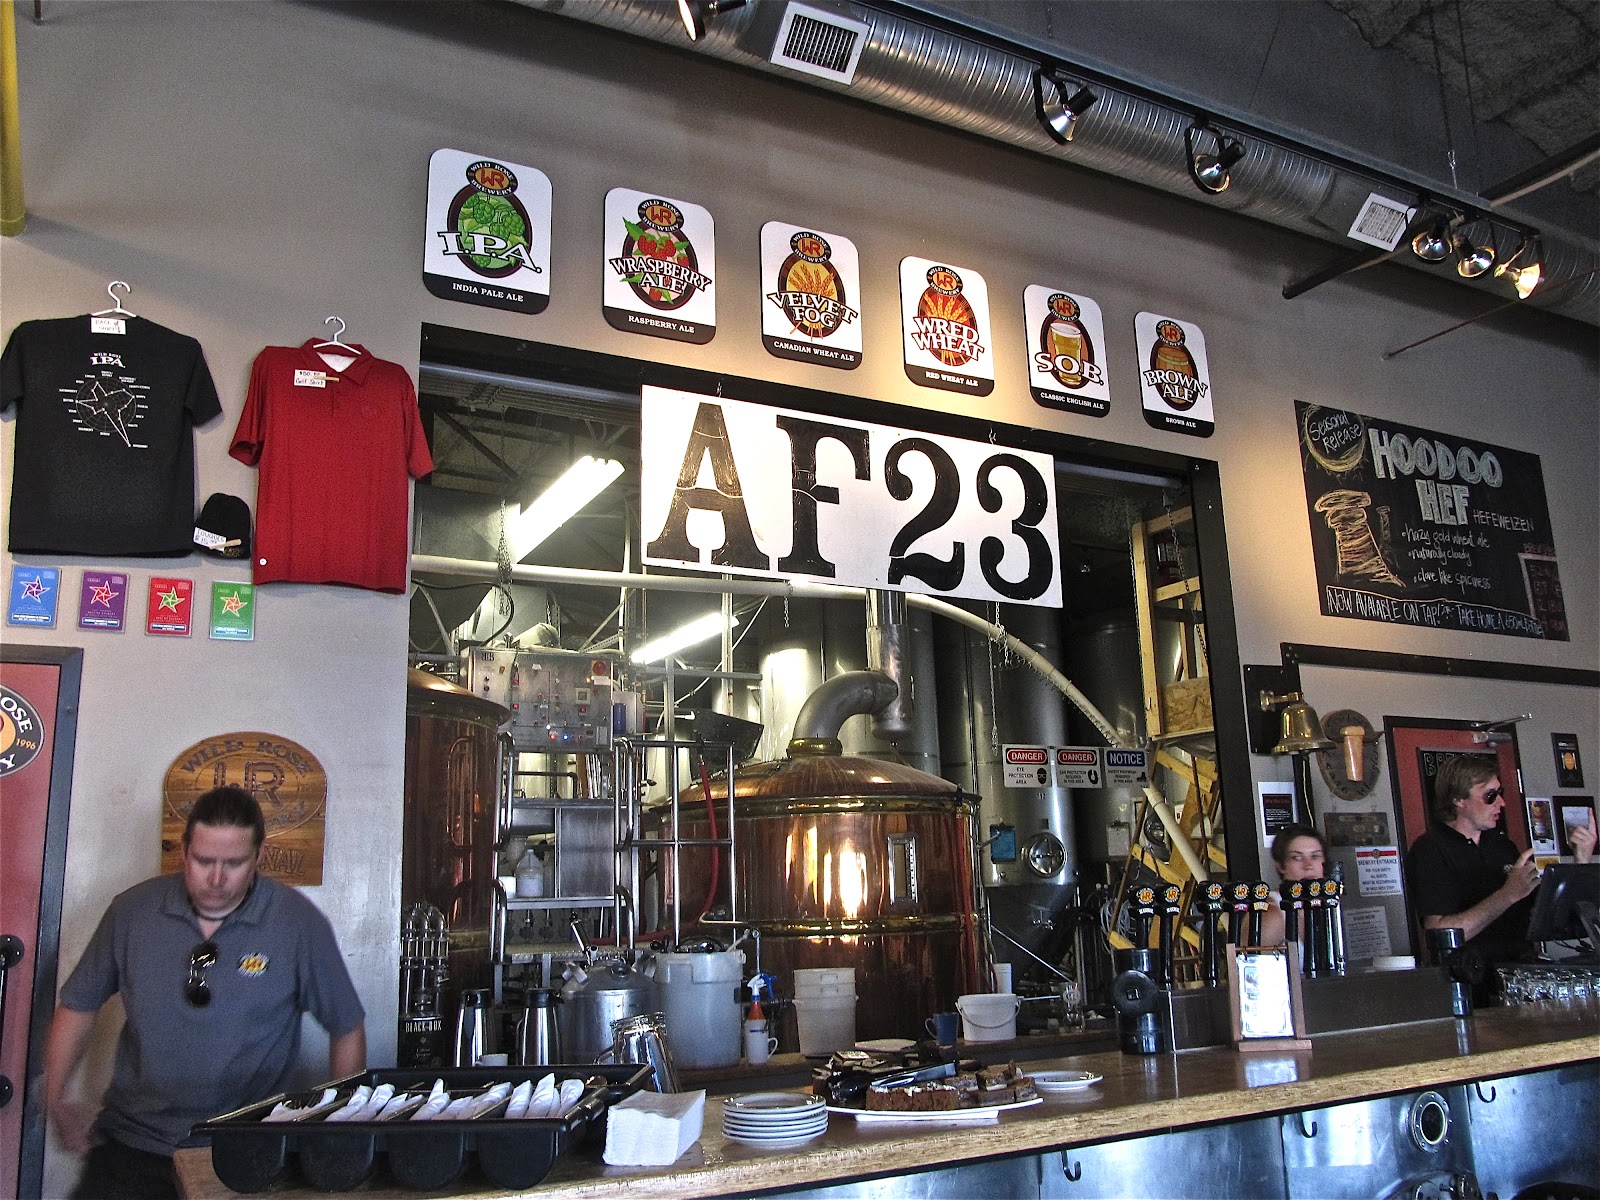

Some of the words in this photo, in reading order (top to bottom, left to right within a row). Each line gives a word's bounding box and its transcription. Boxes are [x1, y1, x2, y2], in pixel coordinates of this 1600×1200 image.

[470, 162, 491, 171] WILD
[494, 164, 514, 180] ROSE
[471, 179, 512, 195] BREWERY
[641, 200, 660, 209] WILD
[642, 216, 679, 231] BREWERY
[609, 257, 712, 292] WRASPBERRY
[640, 273, 686, 294] ALE
[452, 282, 478, 294] INDIA
[480, 287, 504, 299] PALE
[506, 292, 524, 302] ALE
[767, 290, 858, 325] VELVET
[792, 306, 836, 328] FOG
[628, 315, 678, 330] RASPBERRY
[679, 324, 695, 334] ALE
[912, 316, 980, 344] WRED
[774, 341, 811, 354] CANADIAN
[813, 348, 839, 360] WHEAT
[840, 354, 855, 362] ALE
[911, 332, 985, 362] WHEAT
[925, 371, 941, 380] RED
[942, 374, 964, 384] WHEAT
[965, 379, 979, 387] ALE
[1143, 369, 1208, 398] BROWN
[1040, 391, 1065, 403] CLASSIC
[1066, 397, 1092, 408] ENGLISH
[1162, 384, 1194, 403] ALE
[1165, 416, 1185, 425] BROWN
[1309, 410, 1350, 441] Seasonal
[1322, 423, 1362, 455] Release
[1367, 427, 1503, 488] HOODOO
[647, 401, 1053, 600] AF23
[1415, 479, 1470, 526] HEF
[1472, 508, 1535, 533] HEFEWEIZEN
[1405, 522, 1431, 546] hazy
[1432, 530, 1450, 549] gold
[1452, 531, 1475, 547] wheat
[1411, 547, 1448, 566] naturally
[1447, 548, 1473, 567] cloudy
[1417, 567, 1438, 583] clove
[1438, 567, 1453, 585] like
[1328, 589, 1353, 614] NOW
[1403, 602, 1420, 622] ON
[1421, 603, 1441, 626] TAP!
[1457, 604, 1477, 627] TAKE
[1477, 610, 1498, 629] HOME
[1498, 612, 1506, 630] A
[0, 692, 33, 734] OSE
[16, 738, 37, 751] 1996
[181, 739, 244, 774] WILD
[257, 740, 314, 778] ROSE
[1011, 751, 1043, 761] DANGER
[1062, 753, 1093, 762] DANGER
[1109, 752, 1143, 765] NOTICE
[405, 1020, 426, 1033] BLACK
